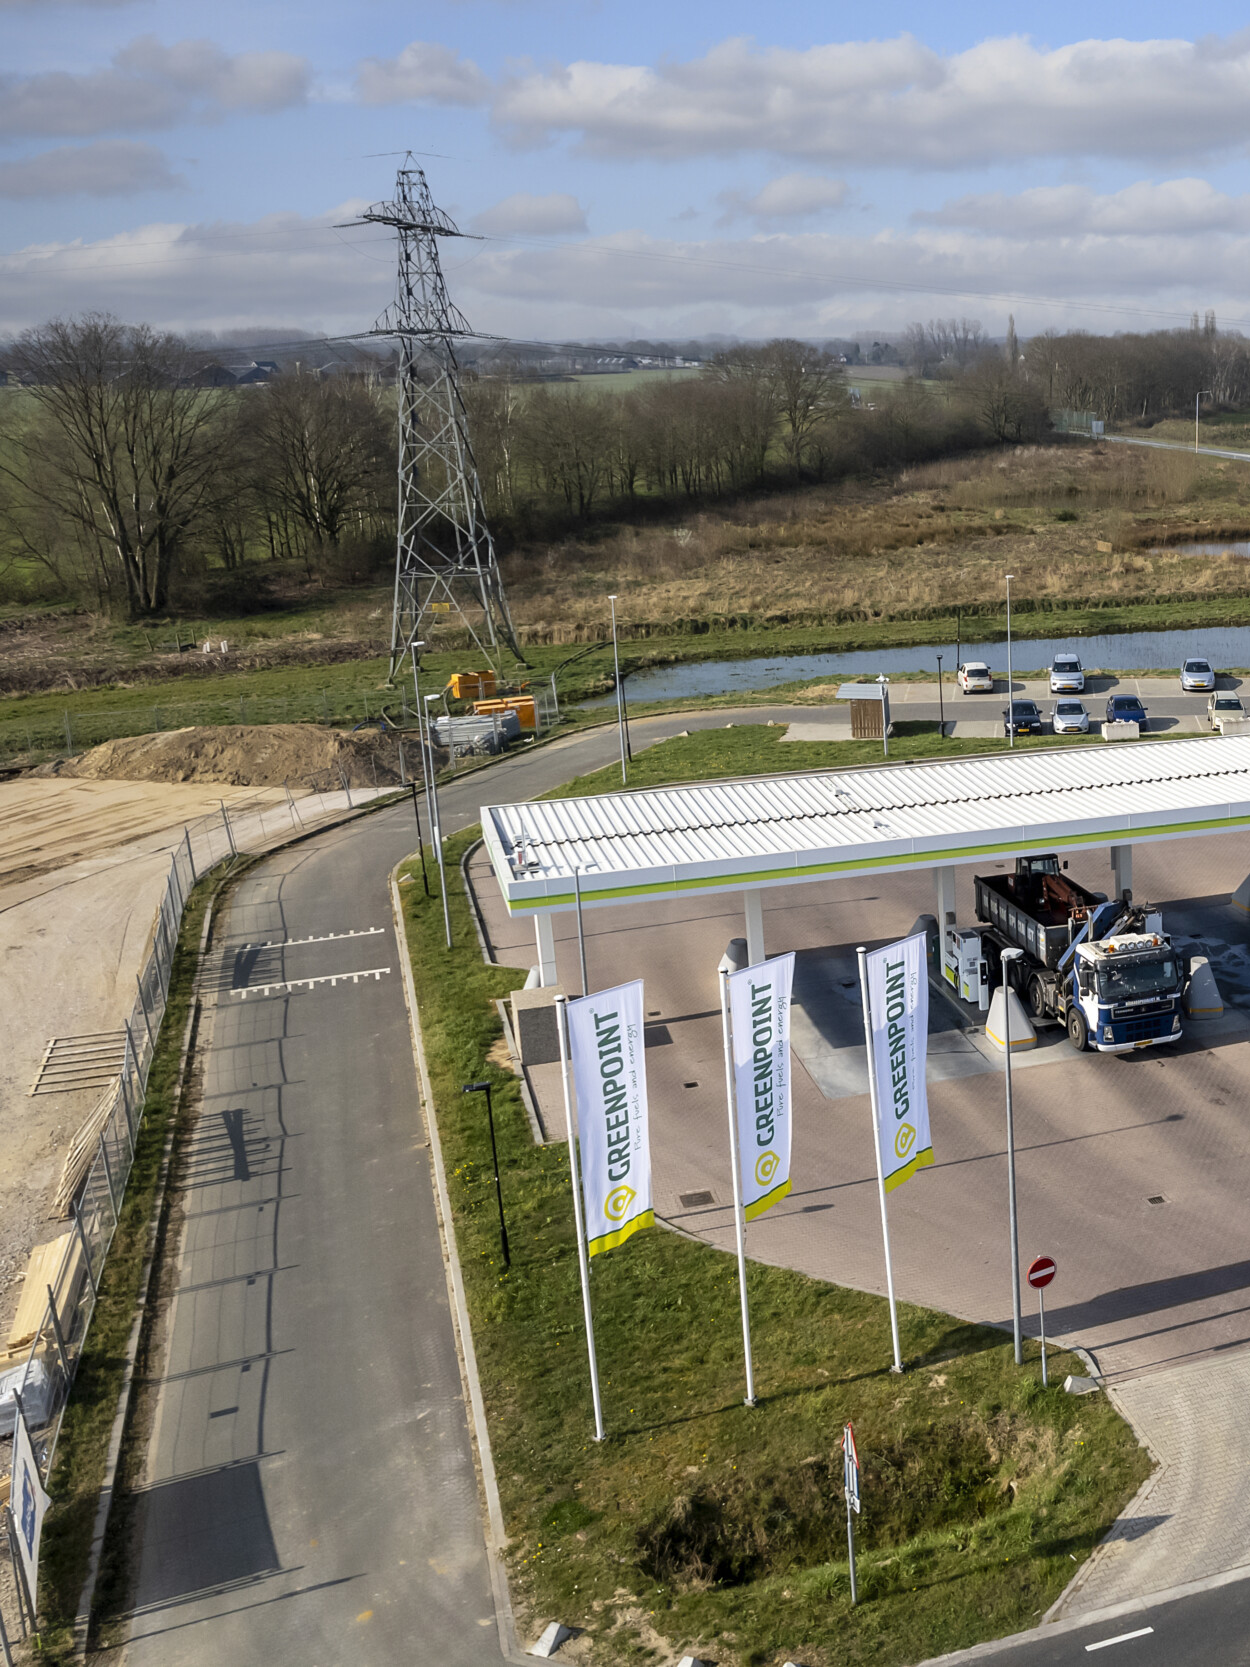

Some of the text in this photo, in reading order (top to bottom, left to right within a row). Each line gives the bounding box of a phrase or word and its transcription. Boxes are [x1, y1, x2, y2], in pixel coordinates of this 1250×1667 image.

[593, 1011, 631, 1182] GREENPOINT
[627, 1023, 638, 1066] energy
[751, 983, 775, 1147] GREENPOINT
[776, 995, 787, 1117] Pure fuels and energy
[885, 960, 910, 1120] GREENPOINT
[631, 1093, 642, 1124] fuels
[634, 1127, 642, 1151] Pure
